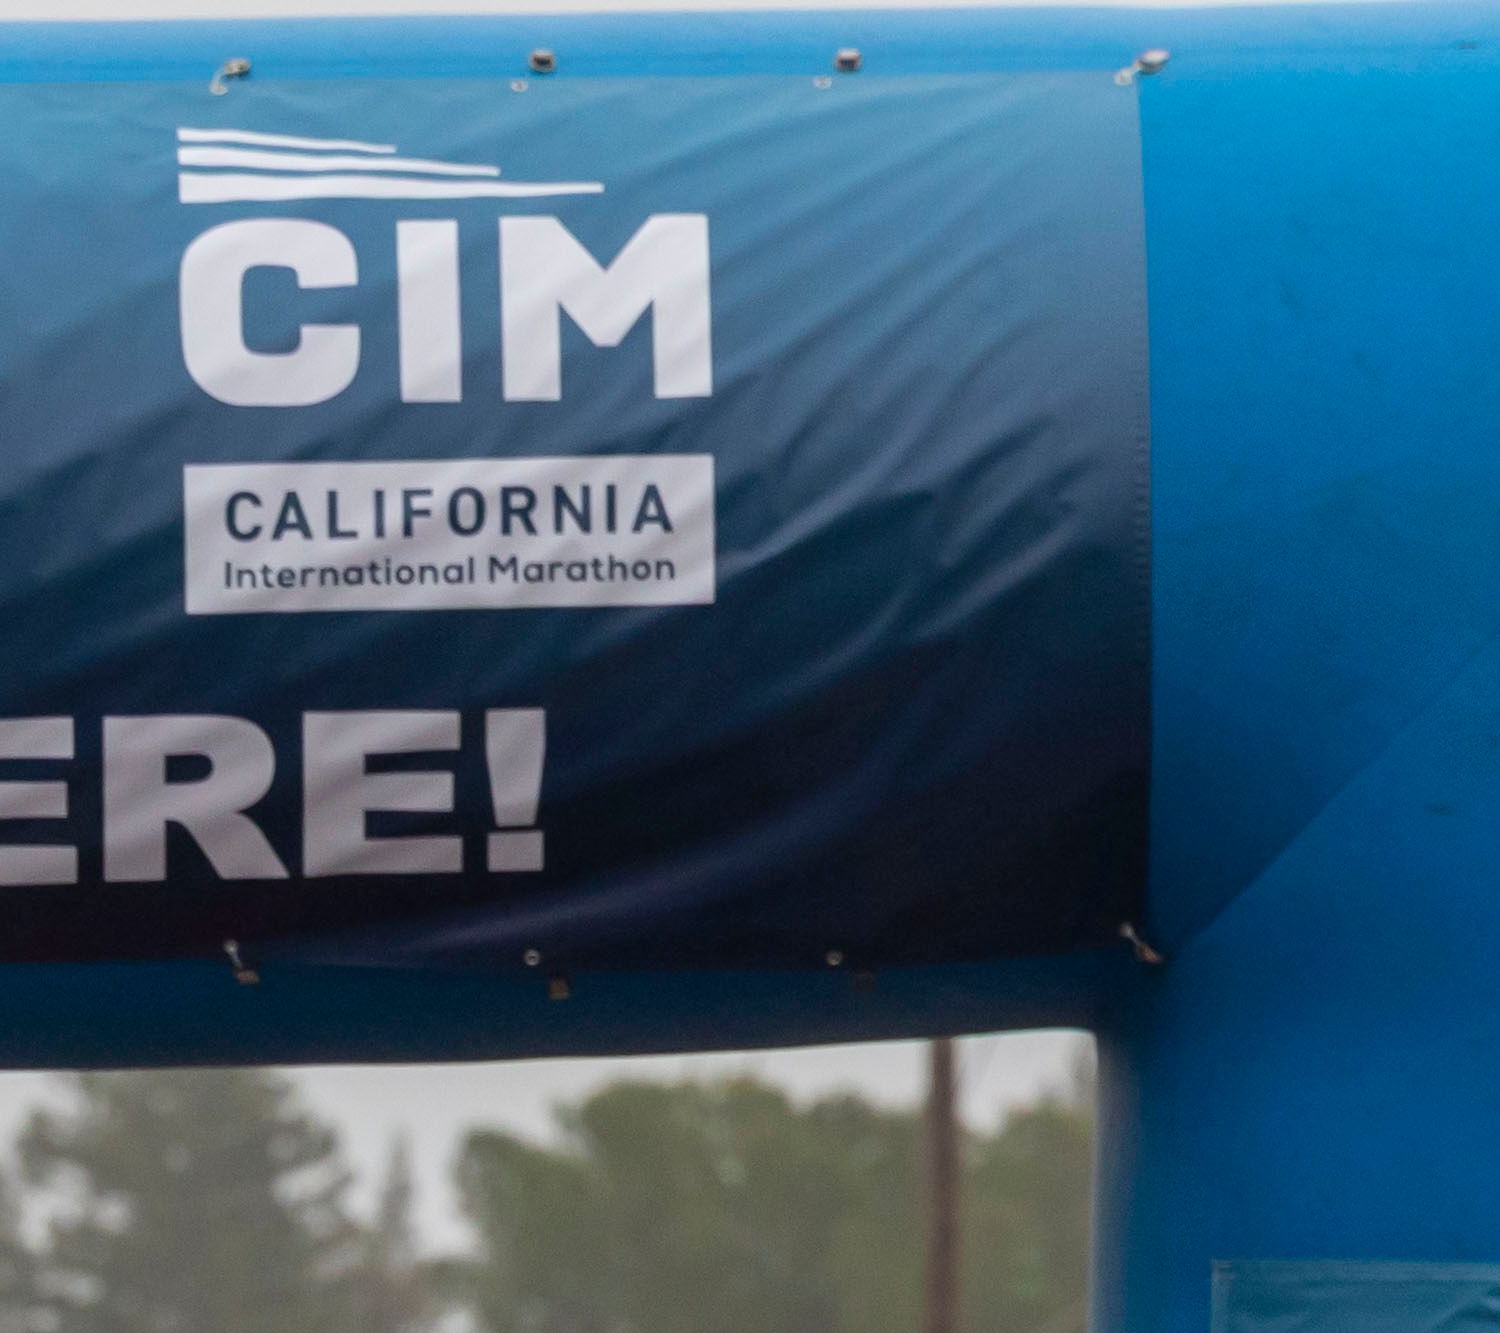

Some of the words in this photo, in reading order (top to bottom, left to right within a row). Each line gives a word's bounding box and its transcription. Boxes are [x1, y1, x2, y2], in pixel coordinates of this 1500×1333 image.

[179, 212, 713, 407] CIM
[223, 483, 676, 543] CALIFORNIA
[223, 556, 476, 591] International
[487, 554, 677, 584] Marathon
